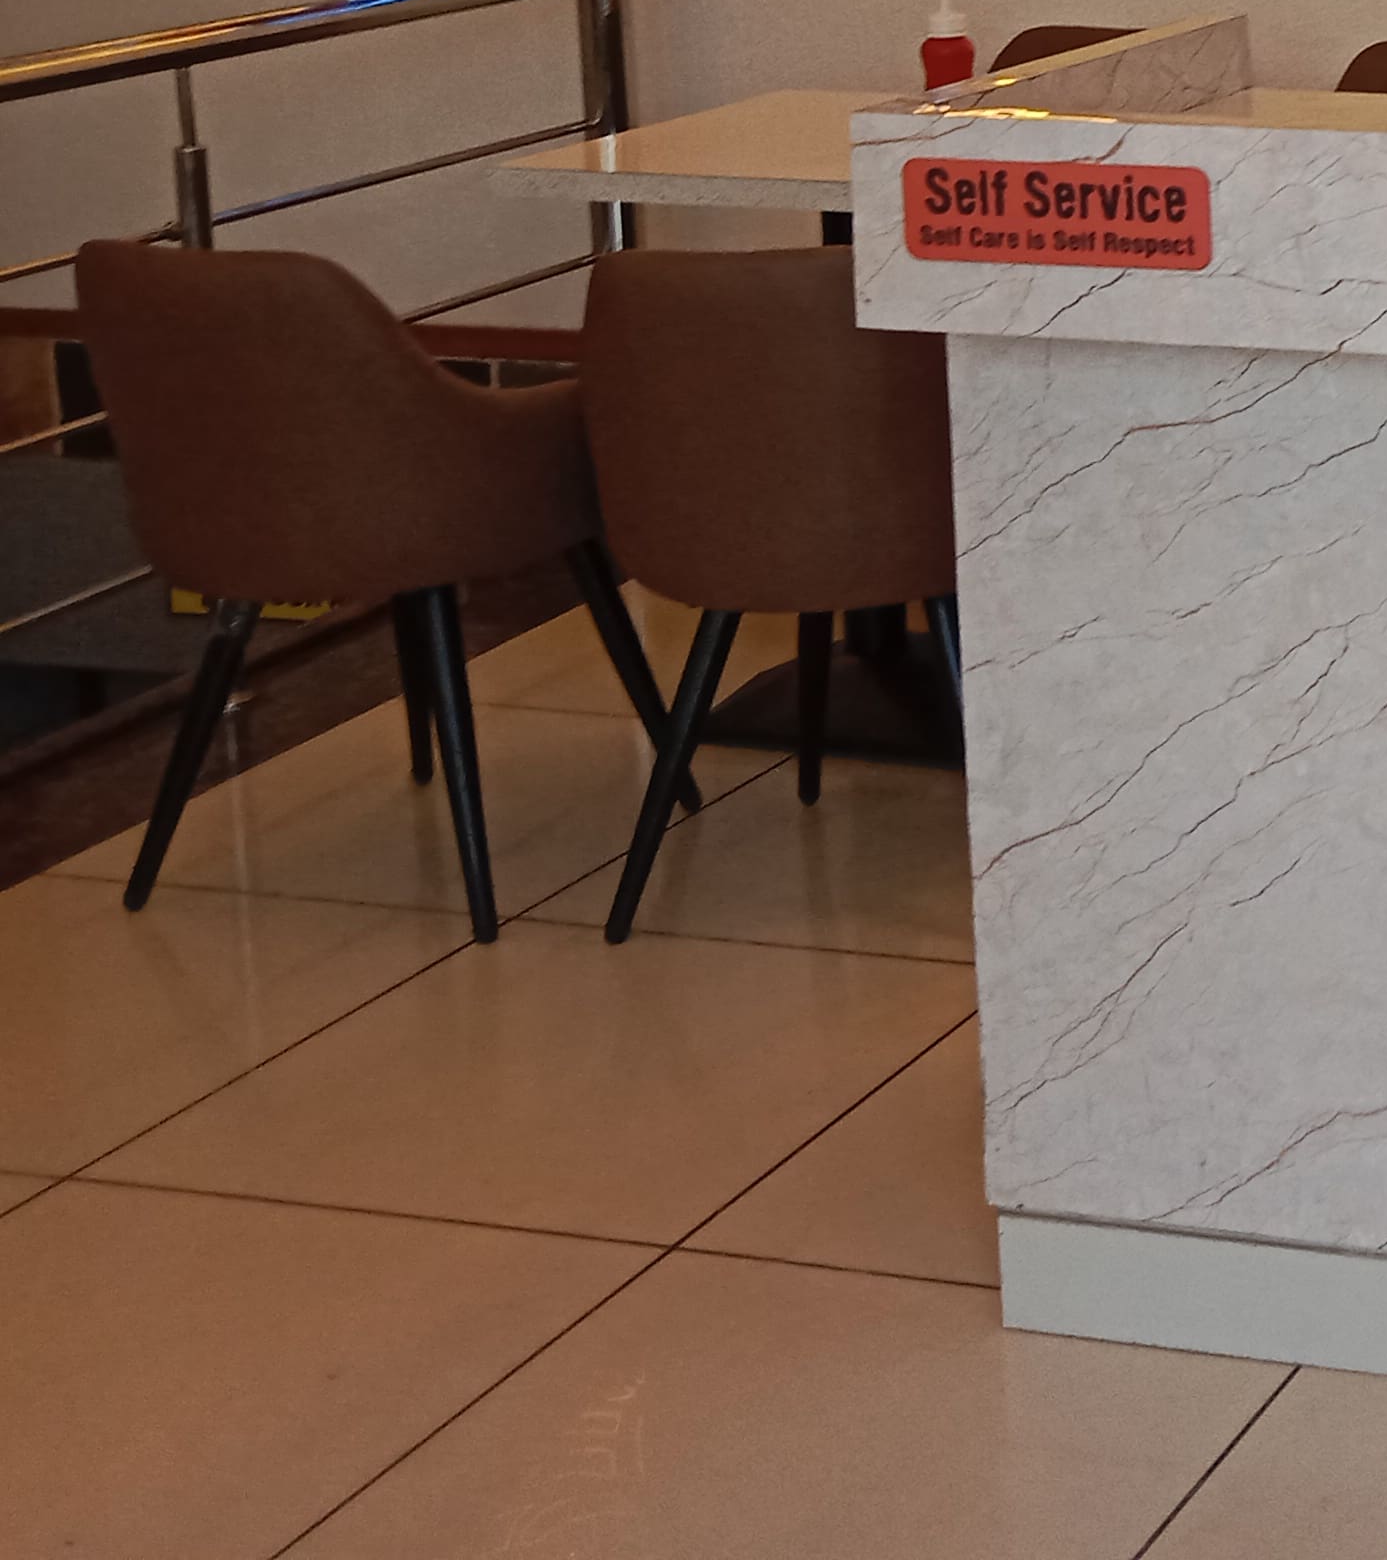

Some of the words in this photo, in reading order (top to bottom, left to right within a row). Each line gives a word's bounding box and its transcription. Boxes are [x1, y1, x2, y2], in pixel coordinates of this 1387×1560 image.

[924, 167, 1008, 218] Self
[1024, 170, 1187, 224] Service
[919, 225, 962, 248] Self
[969, 226, 1019, 249] Care
[1053, 230, 1096, 252] Self
[1103, 231, 1197, 258] Respect
